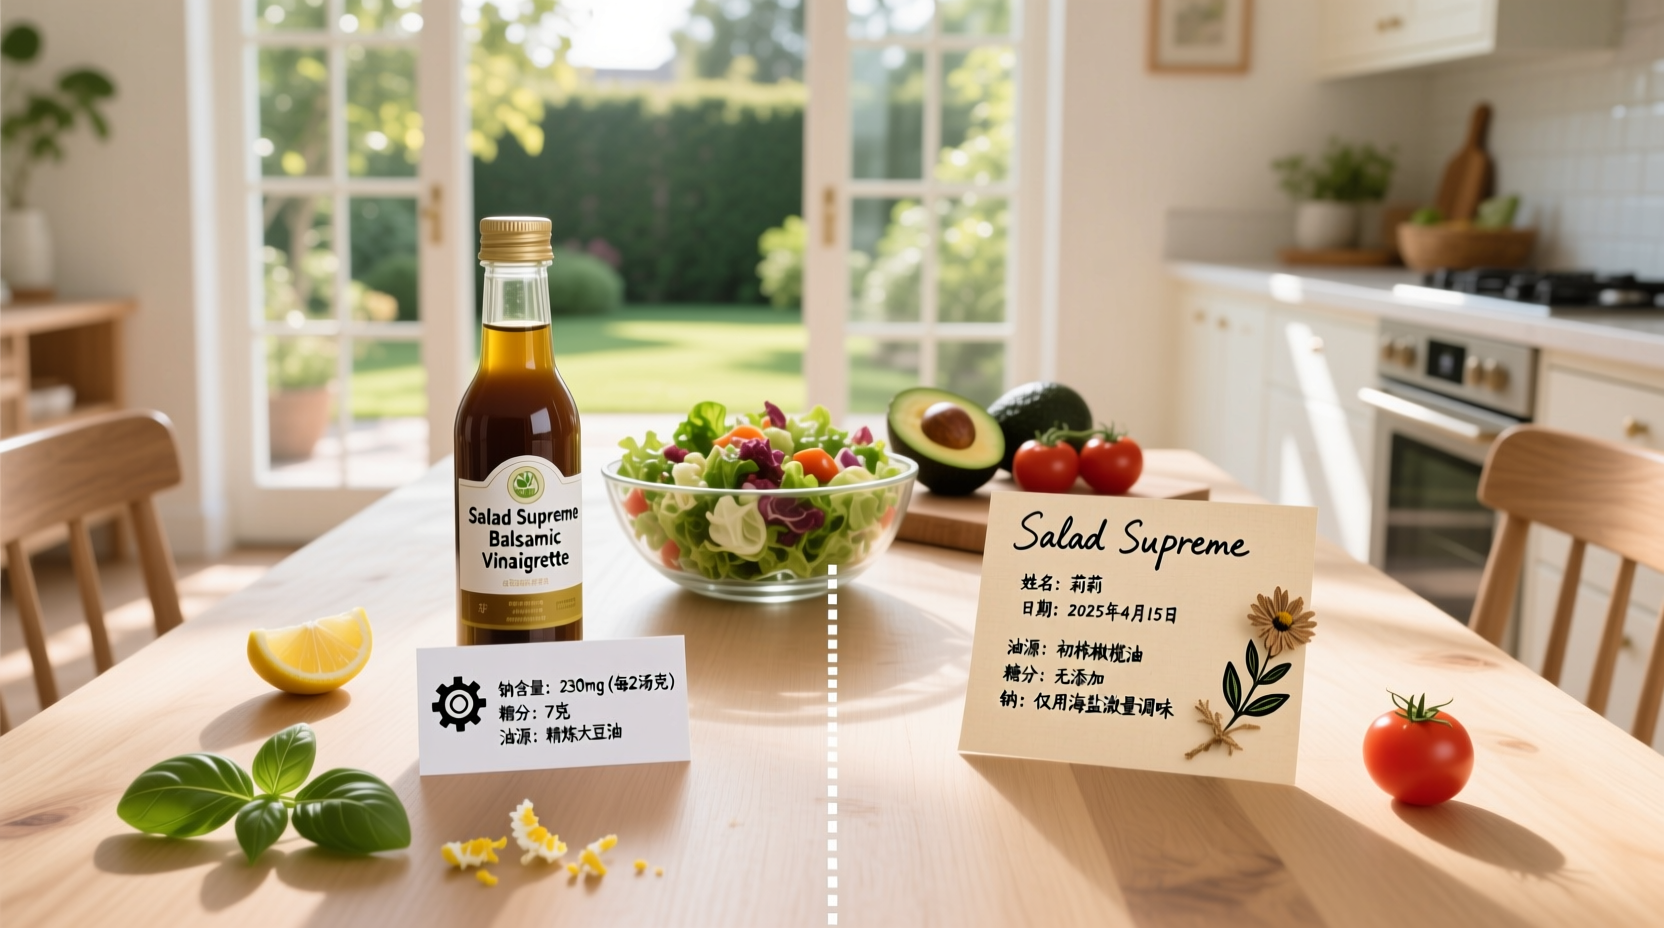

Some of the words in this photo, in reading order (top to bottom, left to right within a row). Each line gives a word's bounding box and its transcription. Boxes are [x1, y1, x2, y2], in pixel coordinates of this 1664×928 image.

[468, 506, 511, 525] Salad
[516, 506, 579, 529] Supreme
[489, 528, 561, 547] Balsamic
[1013, 511, 1108, 550] Salad
[1118, 519, 1250, 571] Supreme
[481, 551, 569, 574] Vinaigrette
